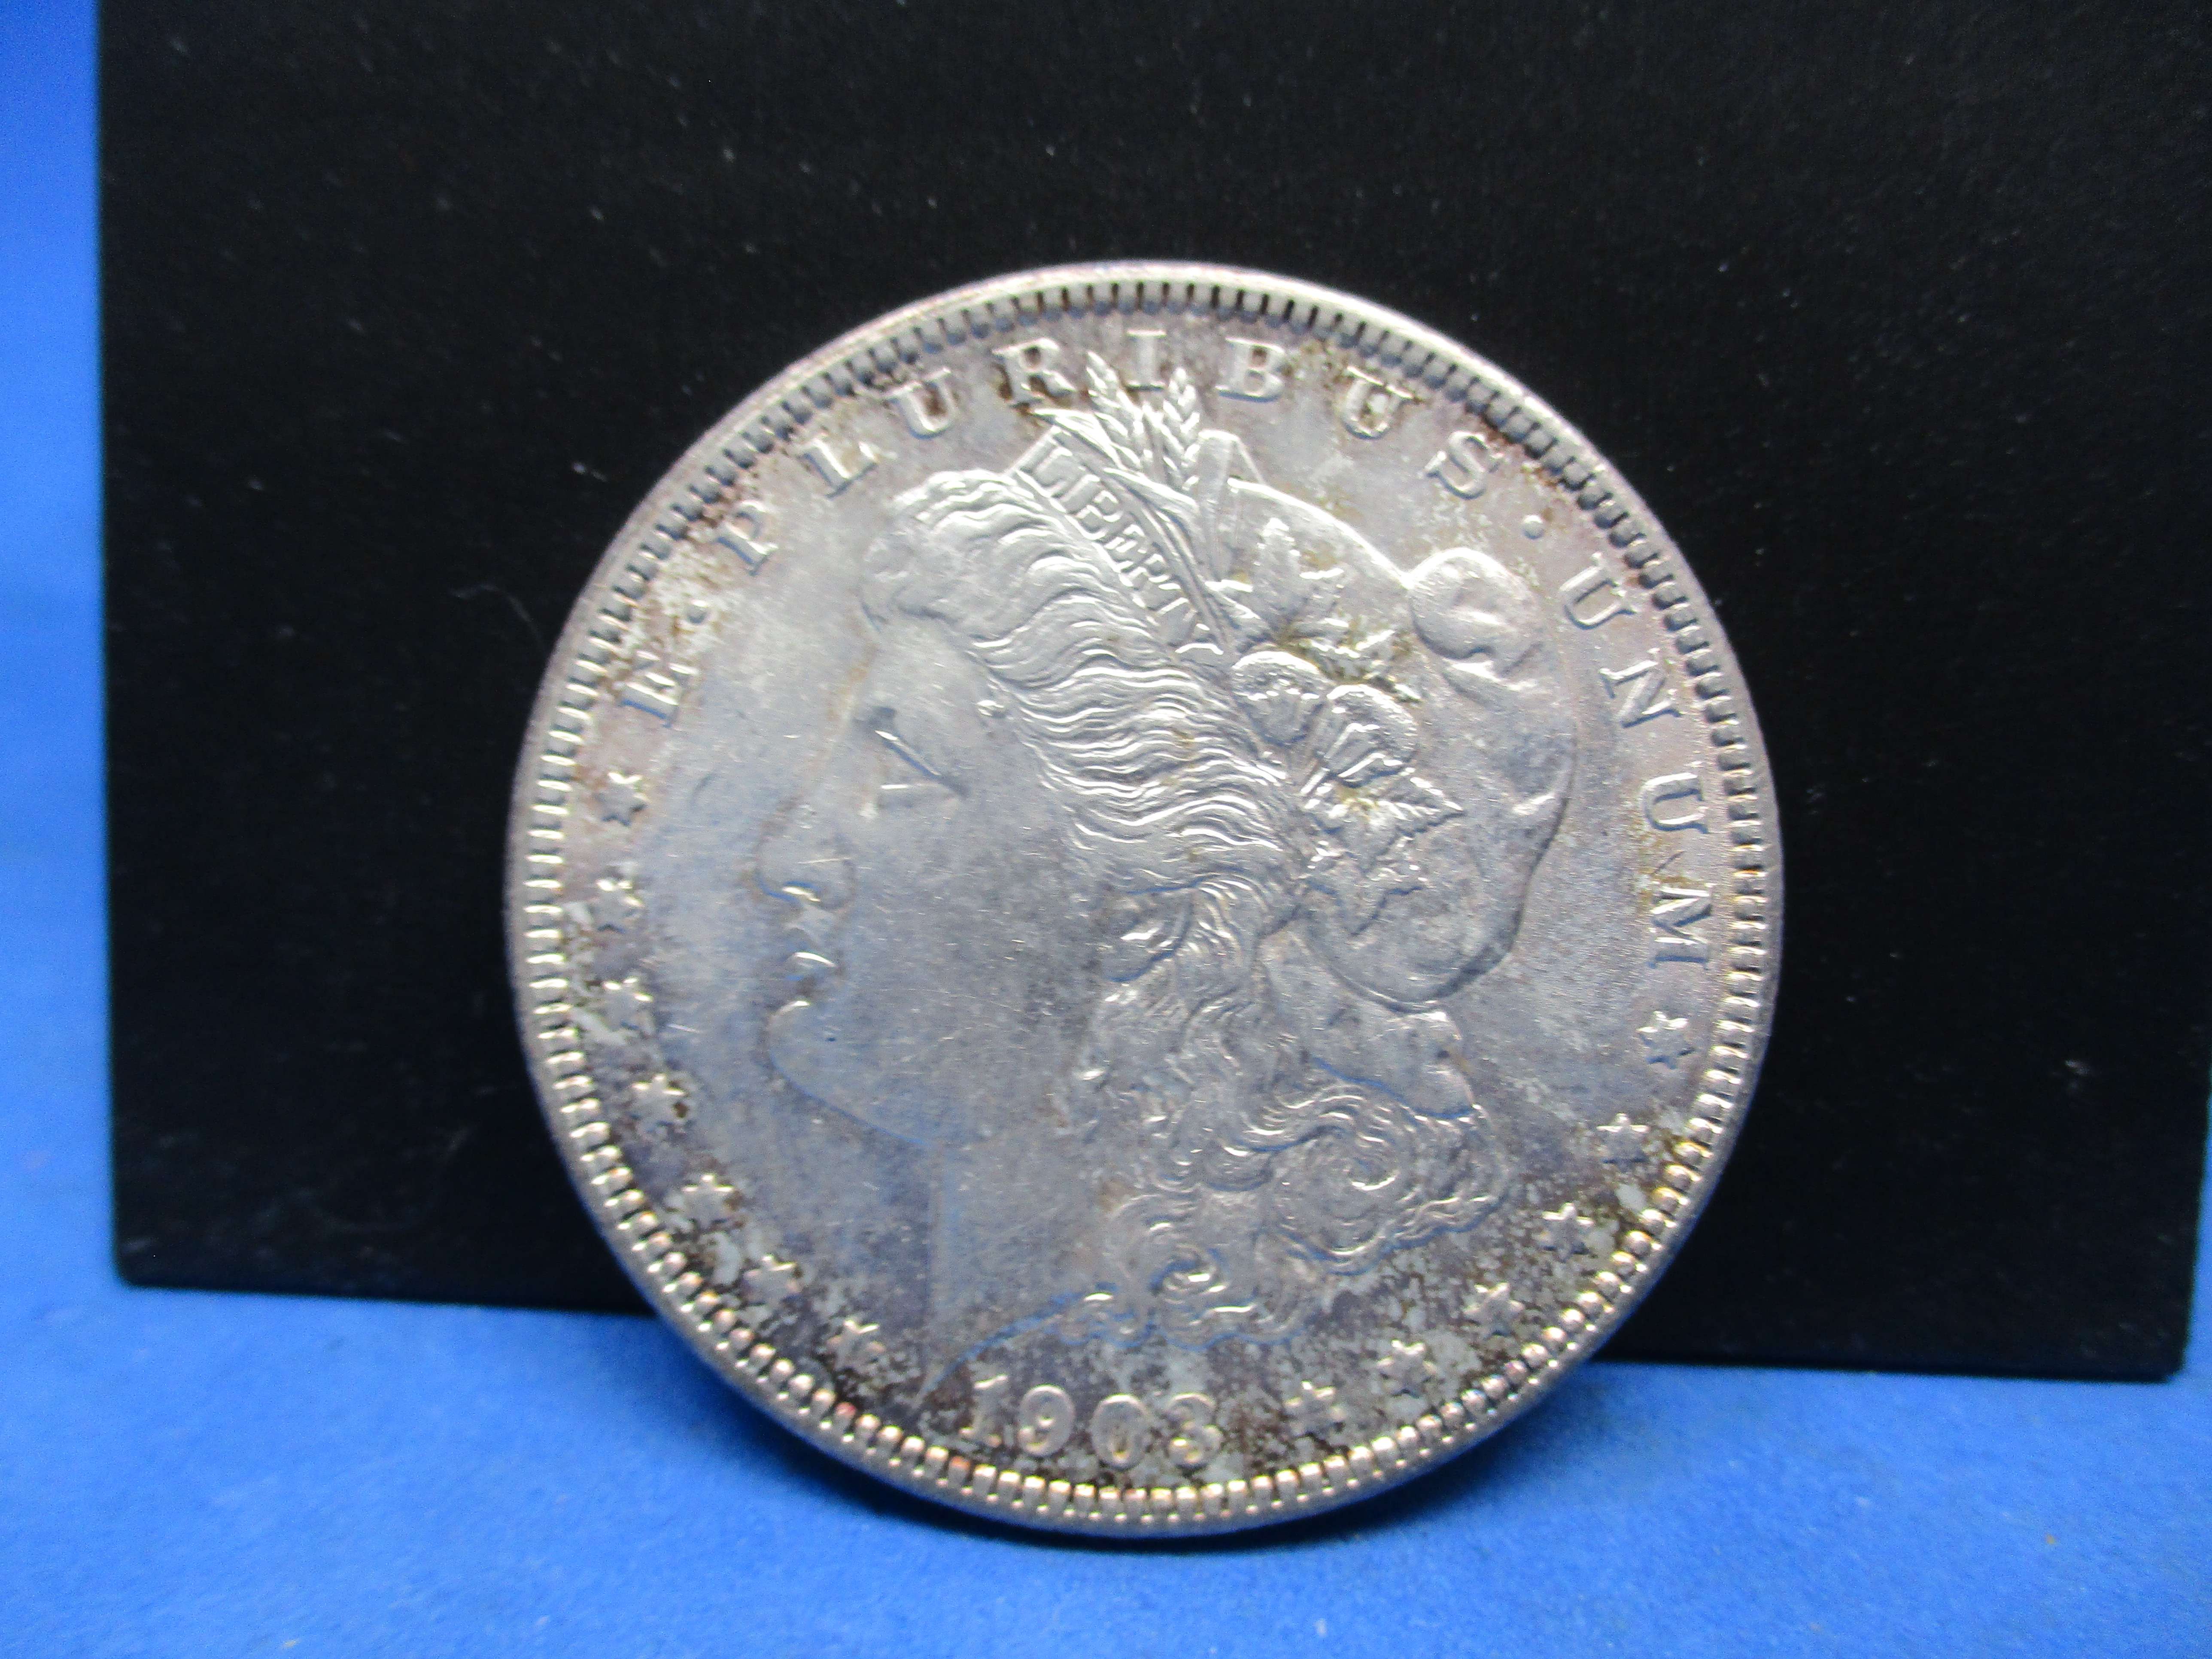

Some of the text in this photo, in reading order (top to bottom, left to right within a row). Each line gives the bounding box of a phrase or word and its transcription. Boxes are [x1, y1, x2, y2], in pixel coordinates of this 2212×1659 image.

[617, 328, 1714, 969] E PLURIBUS UNUM
[959, 1373, 1224, 1469] 1903
